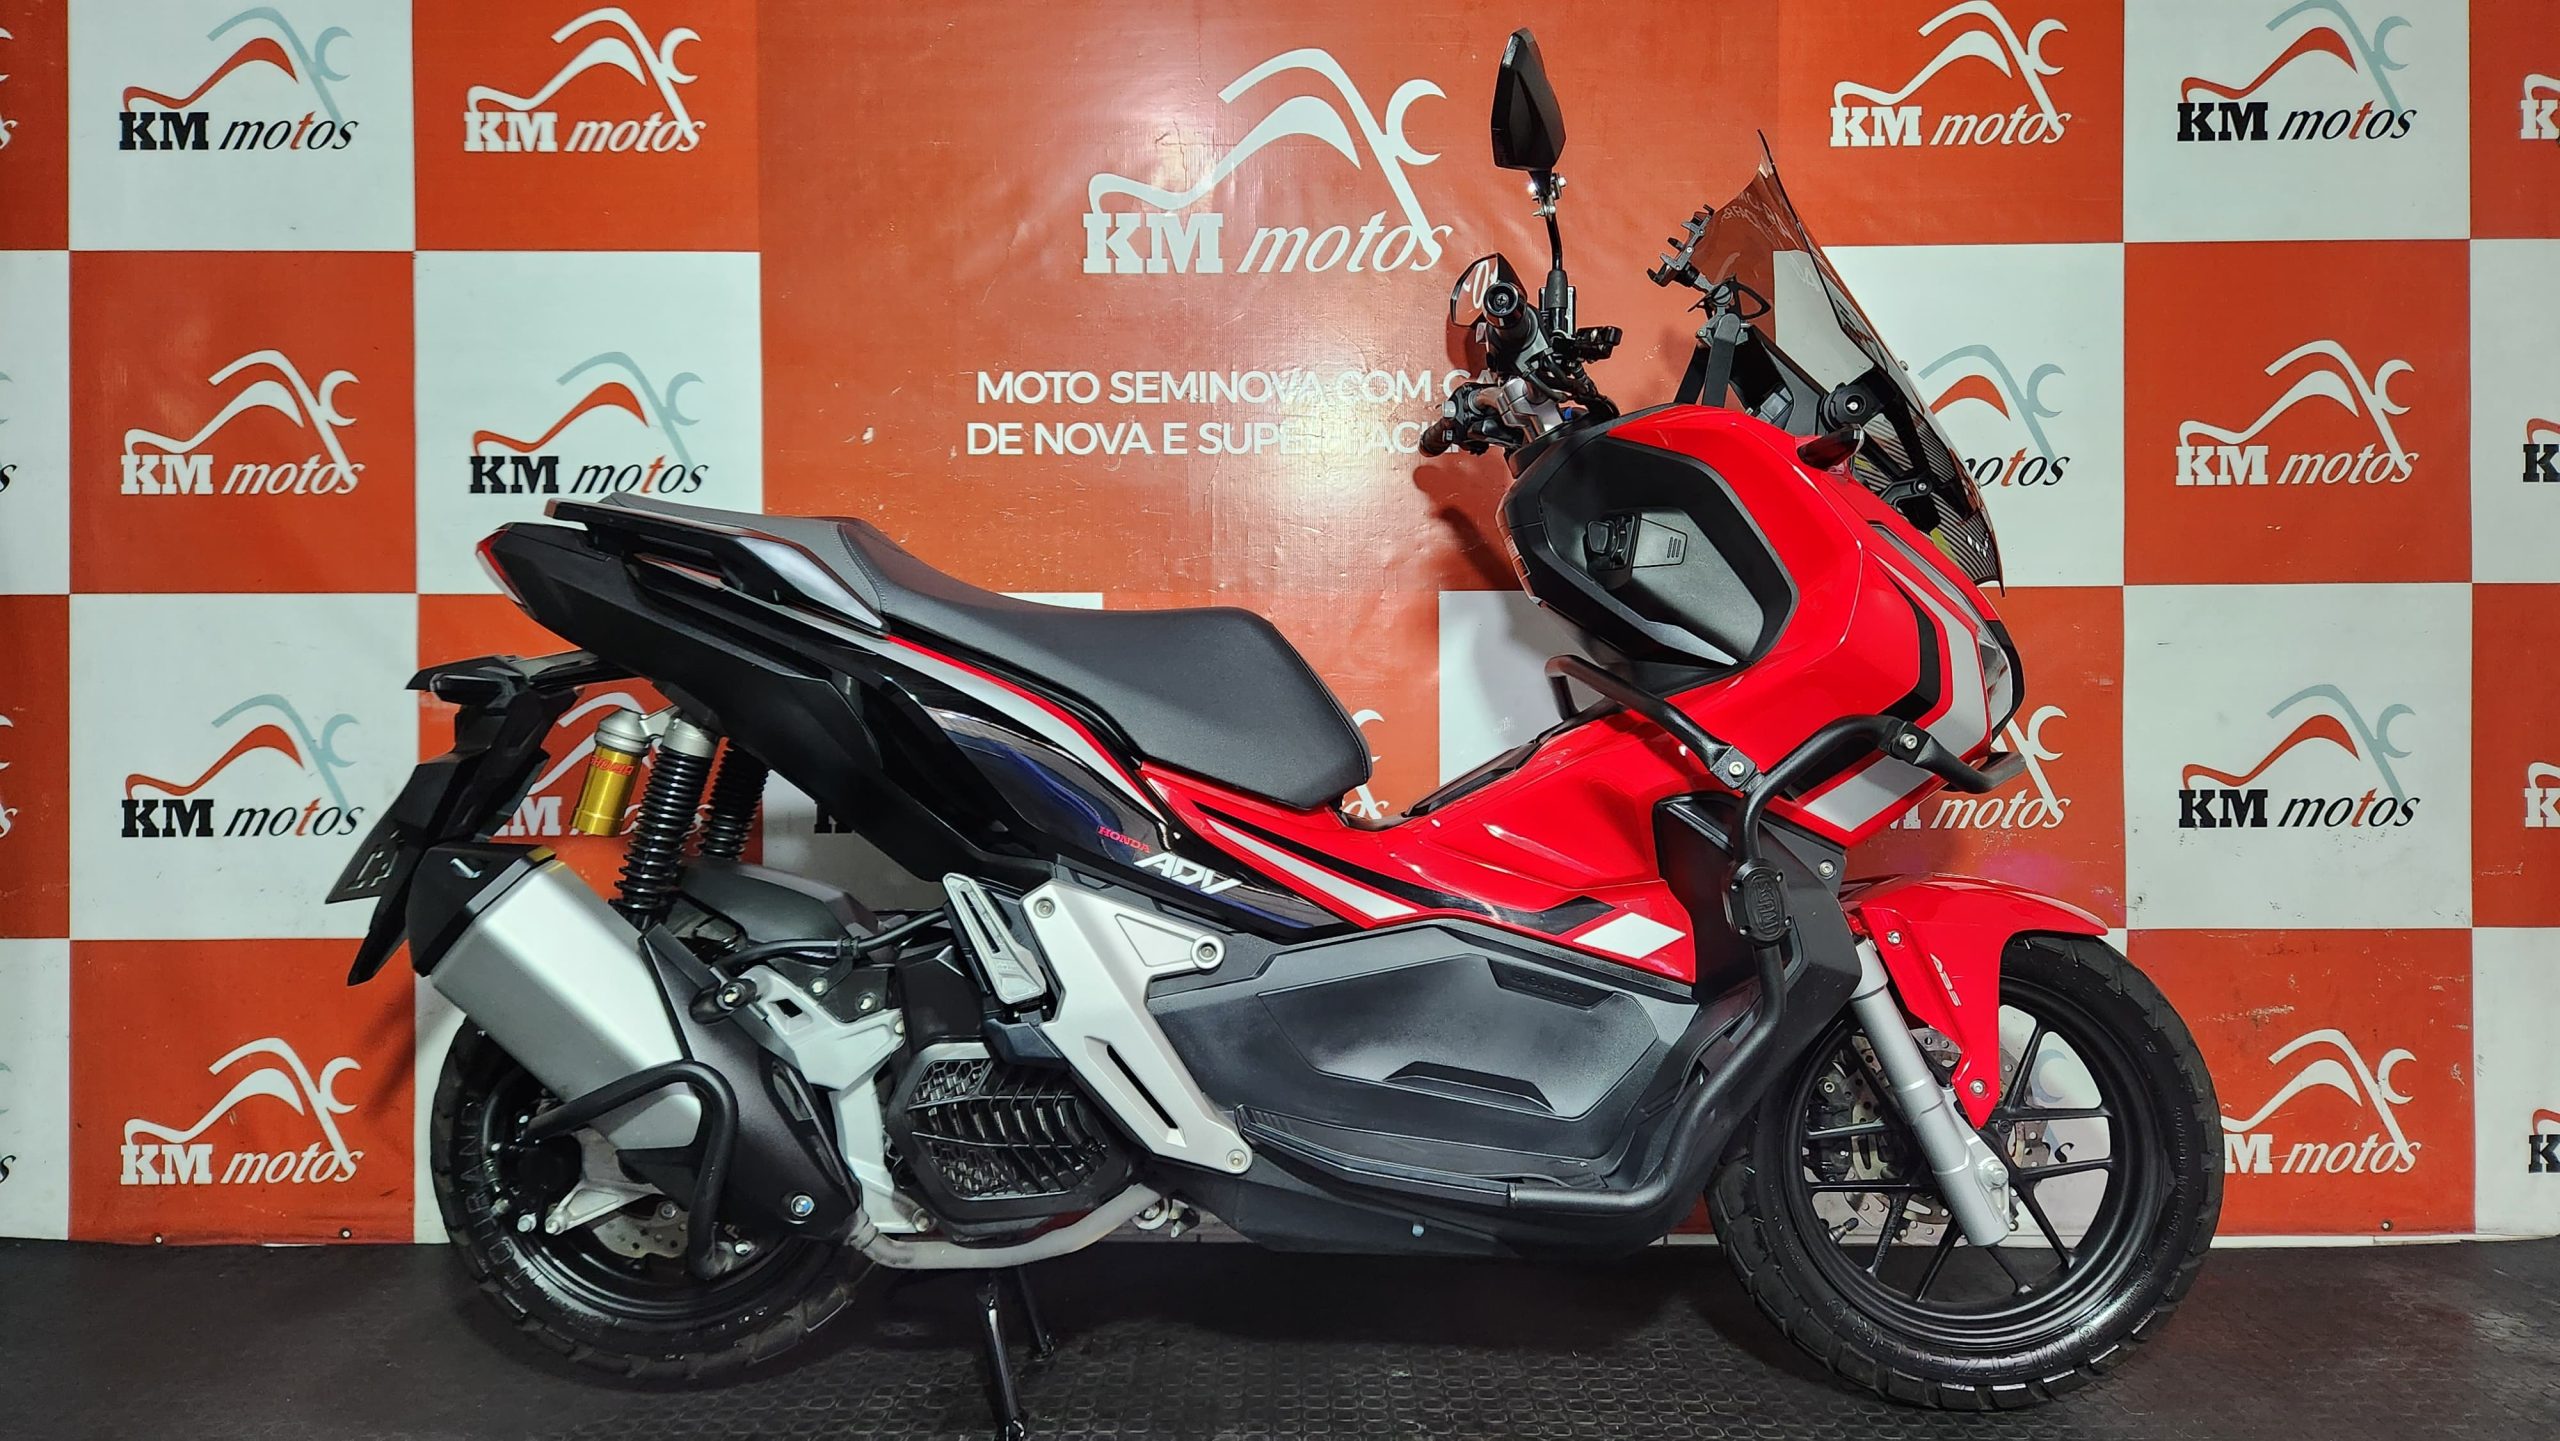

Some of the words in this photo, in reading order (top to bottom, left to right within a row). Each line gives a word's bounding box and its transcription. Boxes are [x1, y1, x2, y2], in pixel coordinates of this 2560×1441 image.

[119, 112, 209, 151] KM
[218, 111, 358, 151] motos
[463, 112, 557, 152] KM
[565, 111, 706, 153] motos
[1829, 105, 1922, 147] KM
[1930, 102, 2071, 146] motos
[2177, 102, 2268, 141] KM
[2277, 100, 2416, 140] motos
[1083, 212, 1223, 273] KM
[1237, 210, 1452, 273] motos
[977, 370, 1101, 404] MOTO
[1108, 370, 1322, 404] SEMINOVA
[1334, 369, 1431, 404] COM
[967, 421, 1026, 455] DE
[1034, 421, 1152, 455] NOVA
[1163, 421, 1187, 455] E
[120, 454, 214, 495] KM
[223, 452, 364, 494] motos
[469, 456, 559, 494] KM
[570, 454, 708, 494] motos
[2175, 446, 2268, 485] KM
[2276, 443, 2418, 485] motos
[121, 799, 214, 838] KM
[223, 797, 364, 838] motos
[495, 796, 562, 836] M
[1930, 790, 2071, 830] motos
[2178, 789, 2268, 828] KM
[2277, 787, 2420, 828] motos
[1098, 825, 1151, 854] HONDA
[1133, 852, 1243, 895] ADV
[120, 1144, 213, 1185] KM
[222, 1142, 363, 1183] motos
[2224, 1133, 2273, 1174] M
[2280, 1132, 2422, 1174] motos
